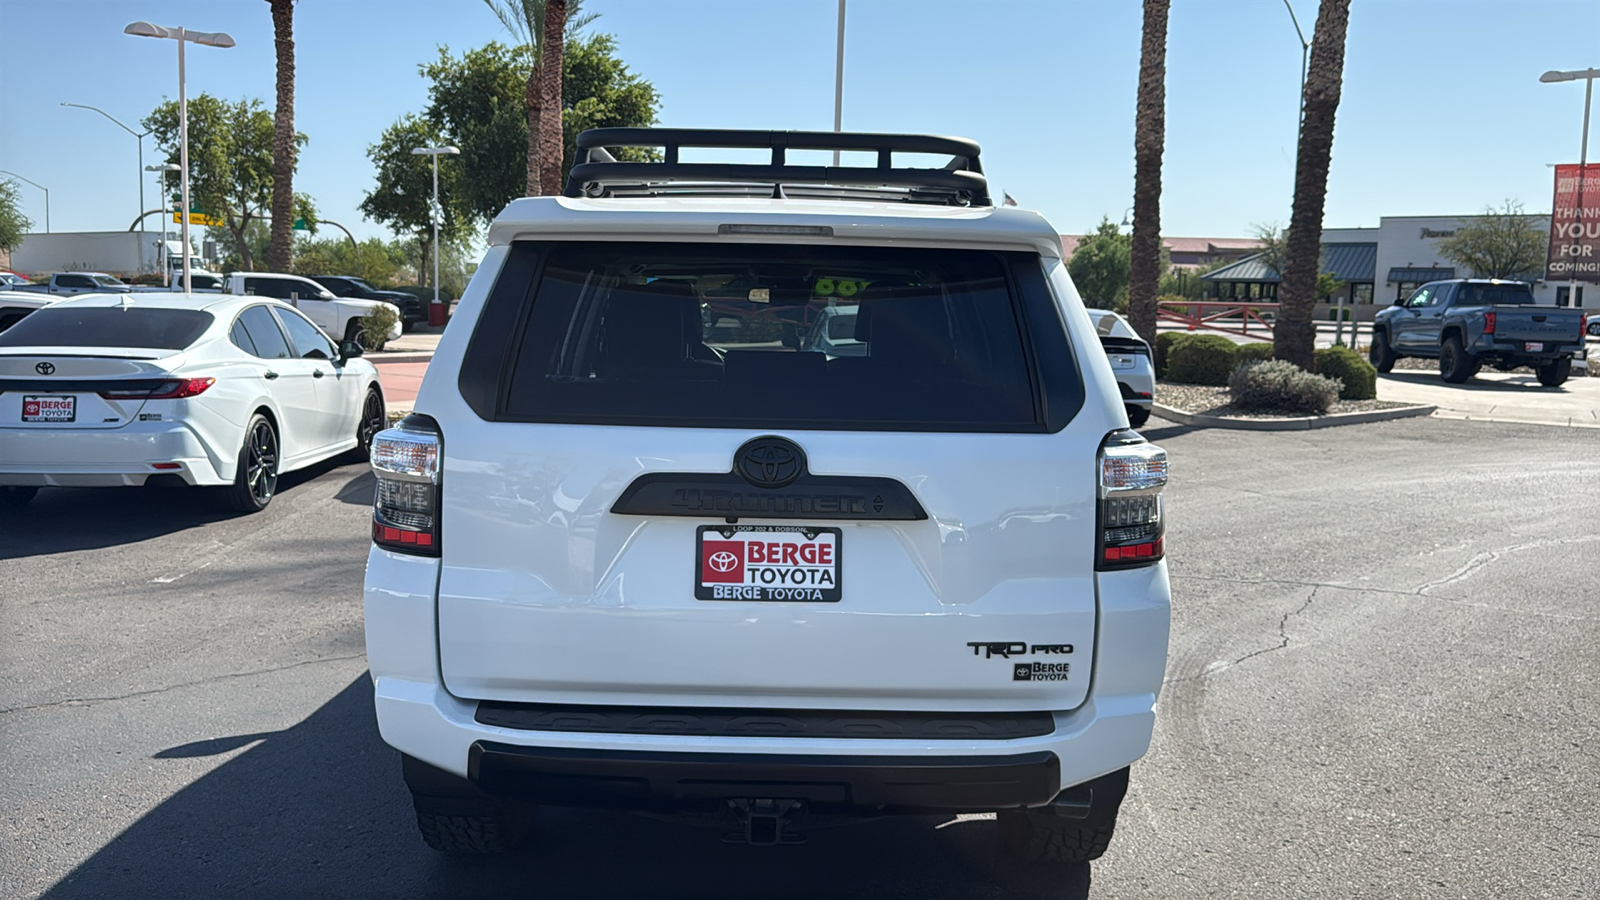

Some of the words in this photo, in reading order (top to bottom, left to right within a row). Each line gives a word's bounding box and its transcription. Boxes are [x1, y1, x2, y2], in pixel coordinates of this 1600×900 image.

[1555, 222, 1600, 238] YOU
[1560, 244, 1592, 257] FOR
[1549, 262, 1600, 272] COMING!
[41, 401, 72, 409] BERGE
[747, 541, 833, 566] BERGE
[747, 568, 834, 585] TOYOTA
[713, 585, 762, 600] BERGE
[766, 588, 823, 600] TOYOTA
[967, 641, 1027, 659] TRD
[1031, 644, 1074, 654] PRO
[1032, 662, 1070, 673] BERGE
